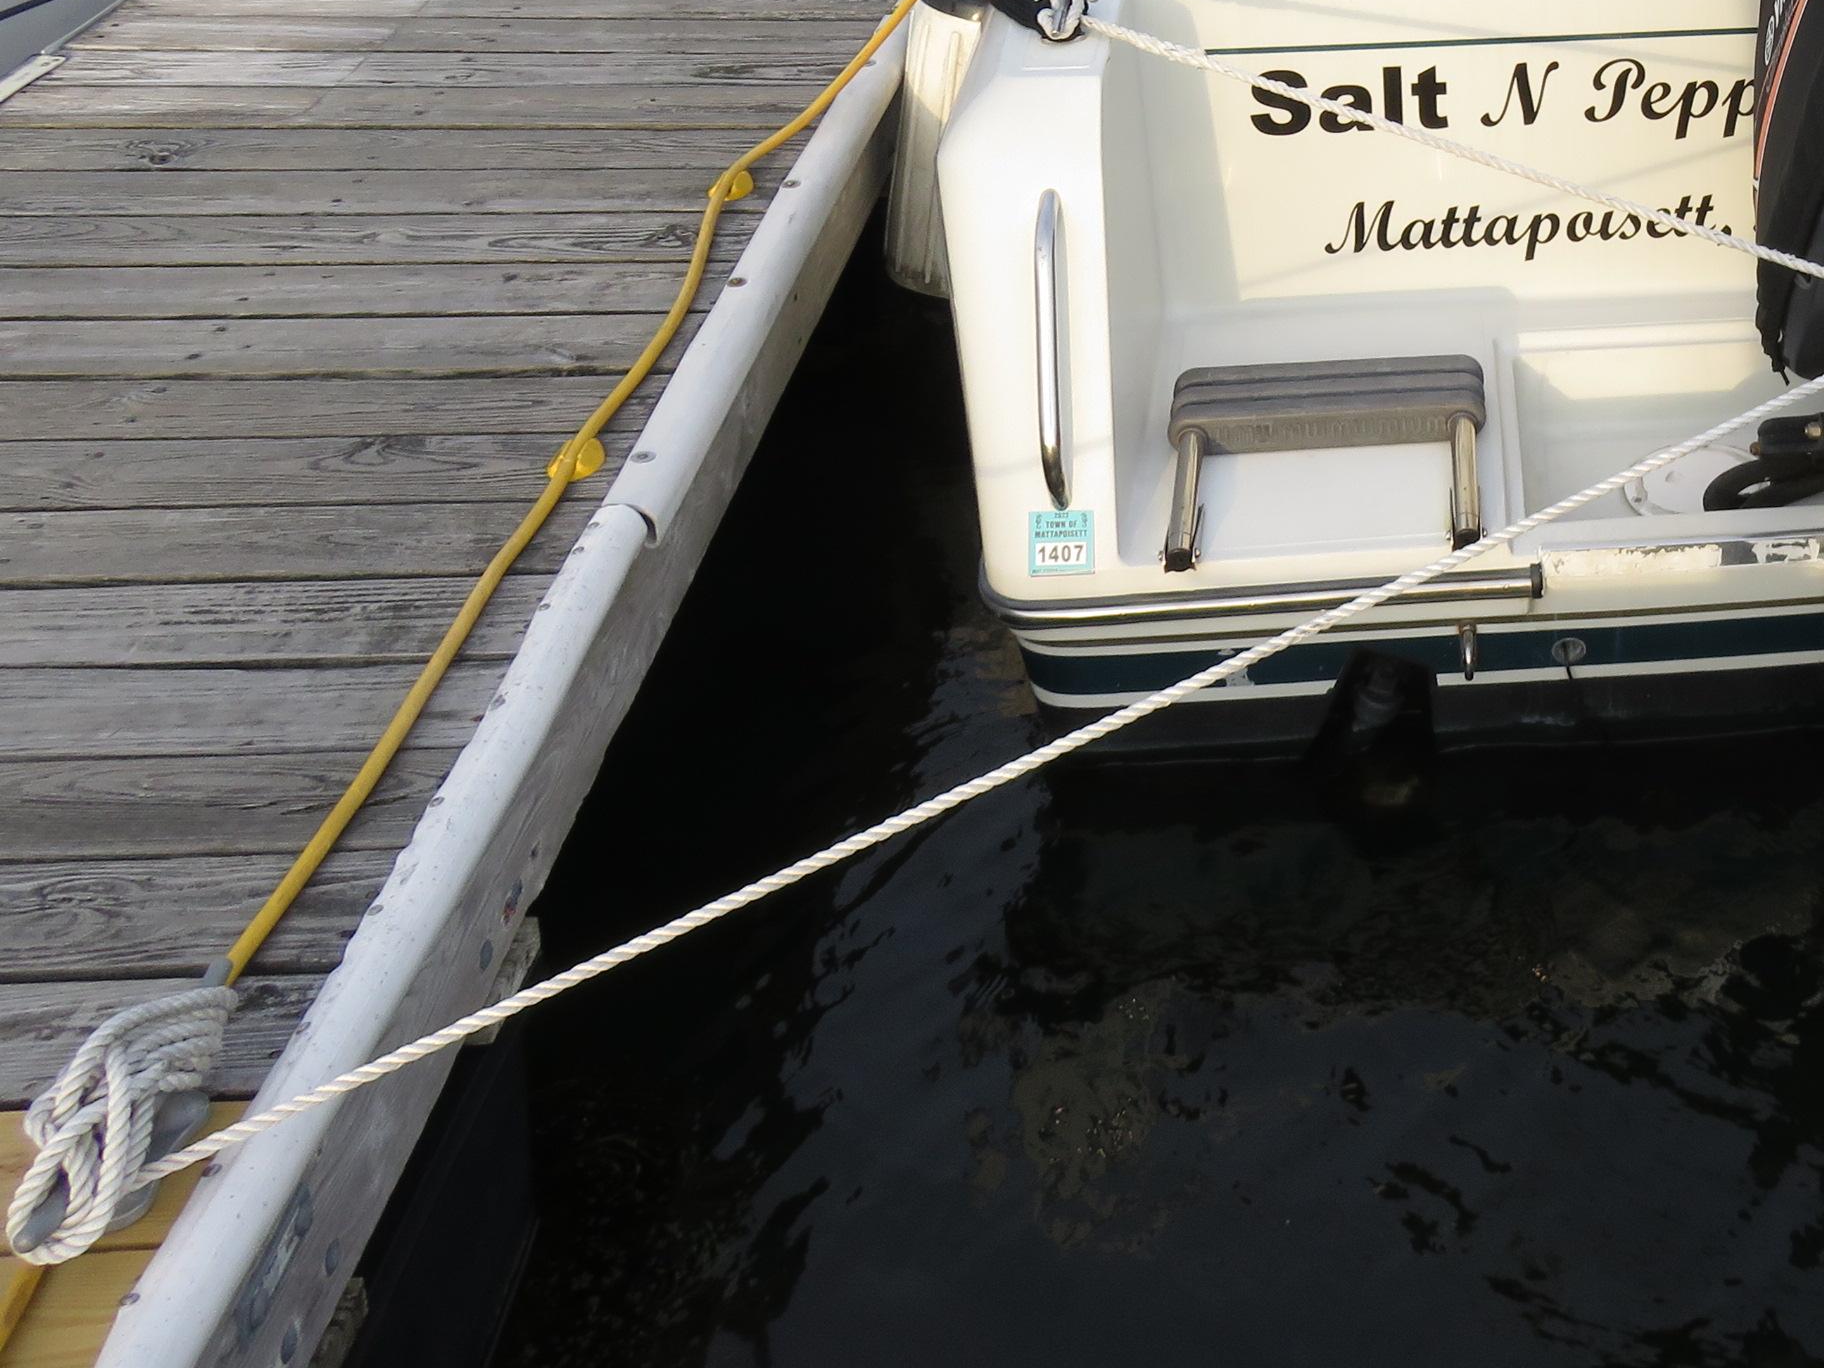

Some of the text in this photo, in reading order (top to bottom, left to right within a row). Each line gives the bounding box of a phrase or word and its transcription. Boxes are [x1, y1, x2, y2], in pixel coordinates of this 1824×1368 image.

[1250, 65, 1449, 137] Salt
[1479, 60, 1560, 128] N
[1045, 520, 1078, 529] TOWN OF
[1034, 529, 1088, 539] MATTAPOISETT
[1038, 544, 1084, 563] 1407
